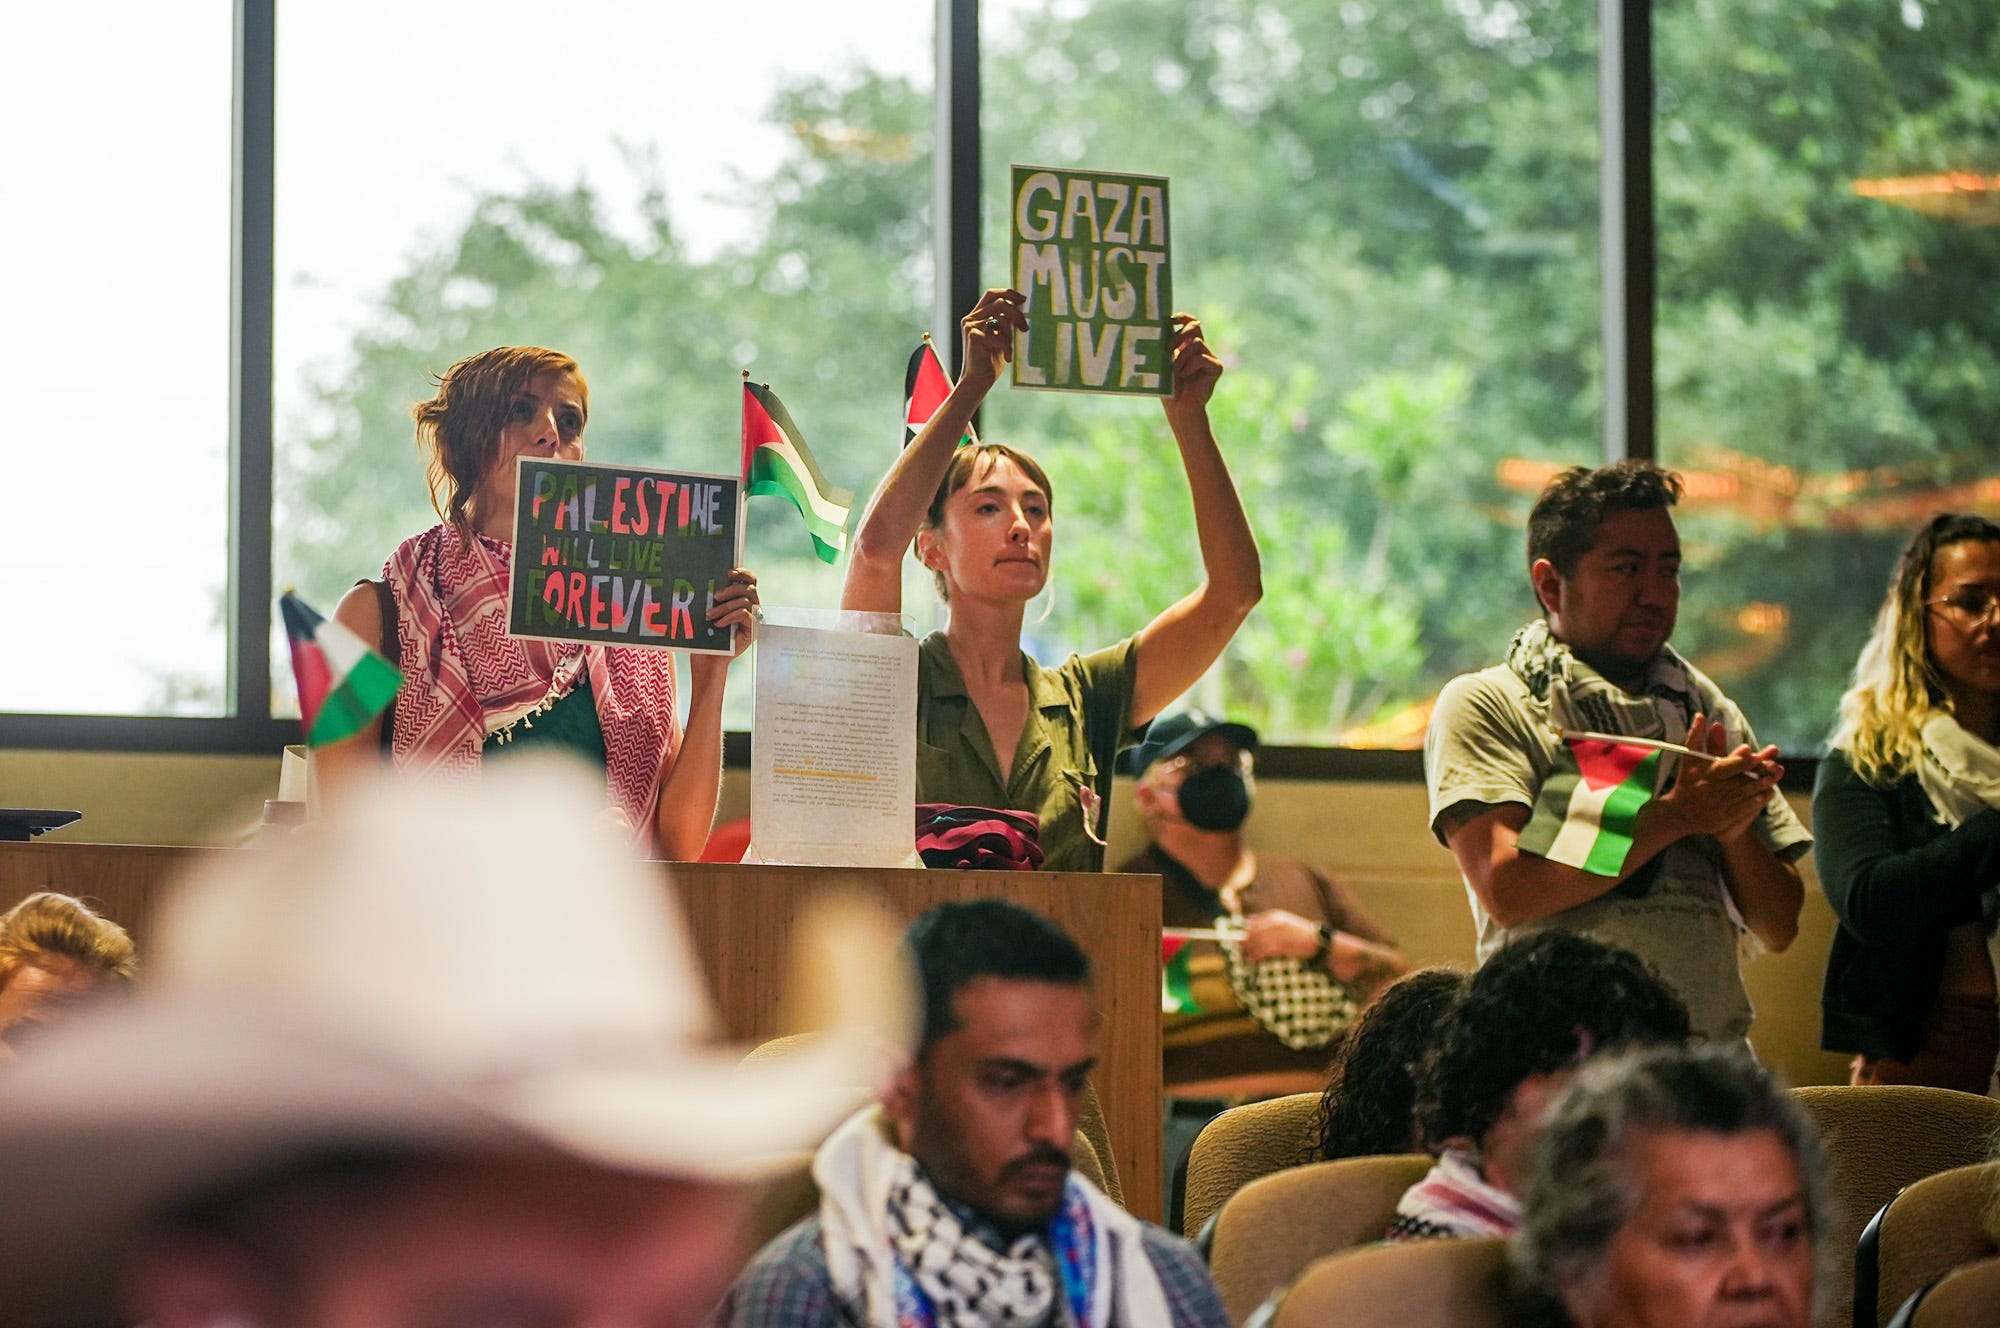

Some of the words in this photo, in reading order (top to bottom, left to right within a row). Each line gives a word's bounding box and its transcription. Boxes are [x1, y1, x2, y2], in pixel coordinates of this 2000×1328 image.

[1016, 172, 1165, 246] GAZA
[1016, 243, 1166, 320] MUST
[1015, 318, 1162, 388] LIVE
[532, 471, 723, 538] PALESTINE
[541, 535, 600, 569] WILL
[609, 538, 665, 573] LIVE
